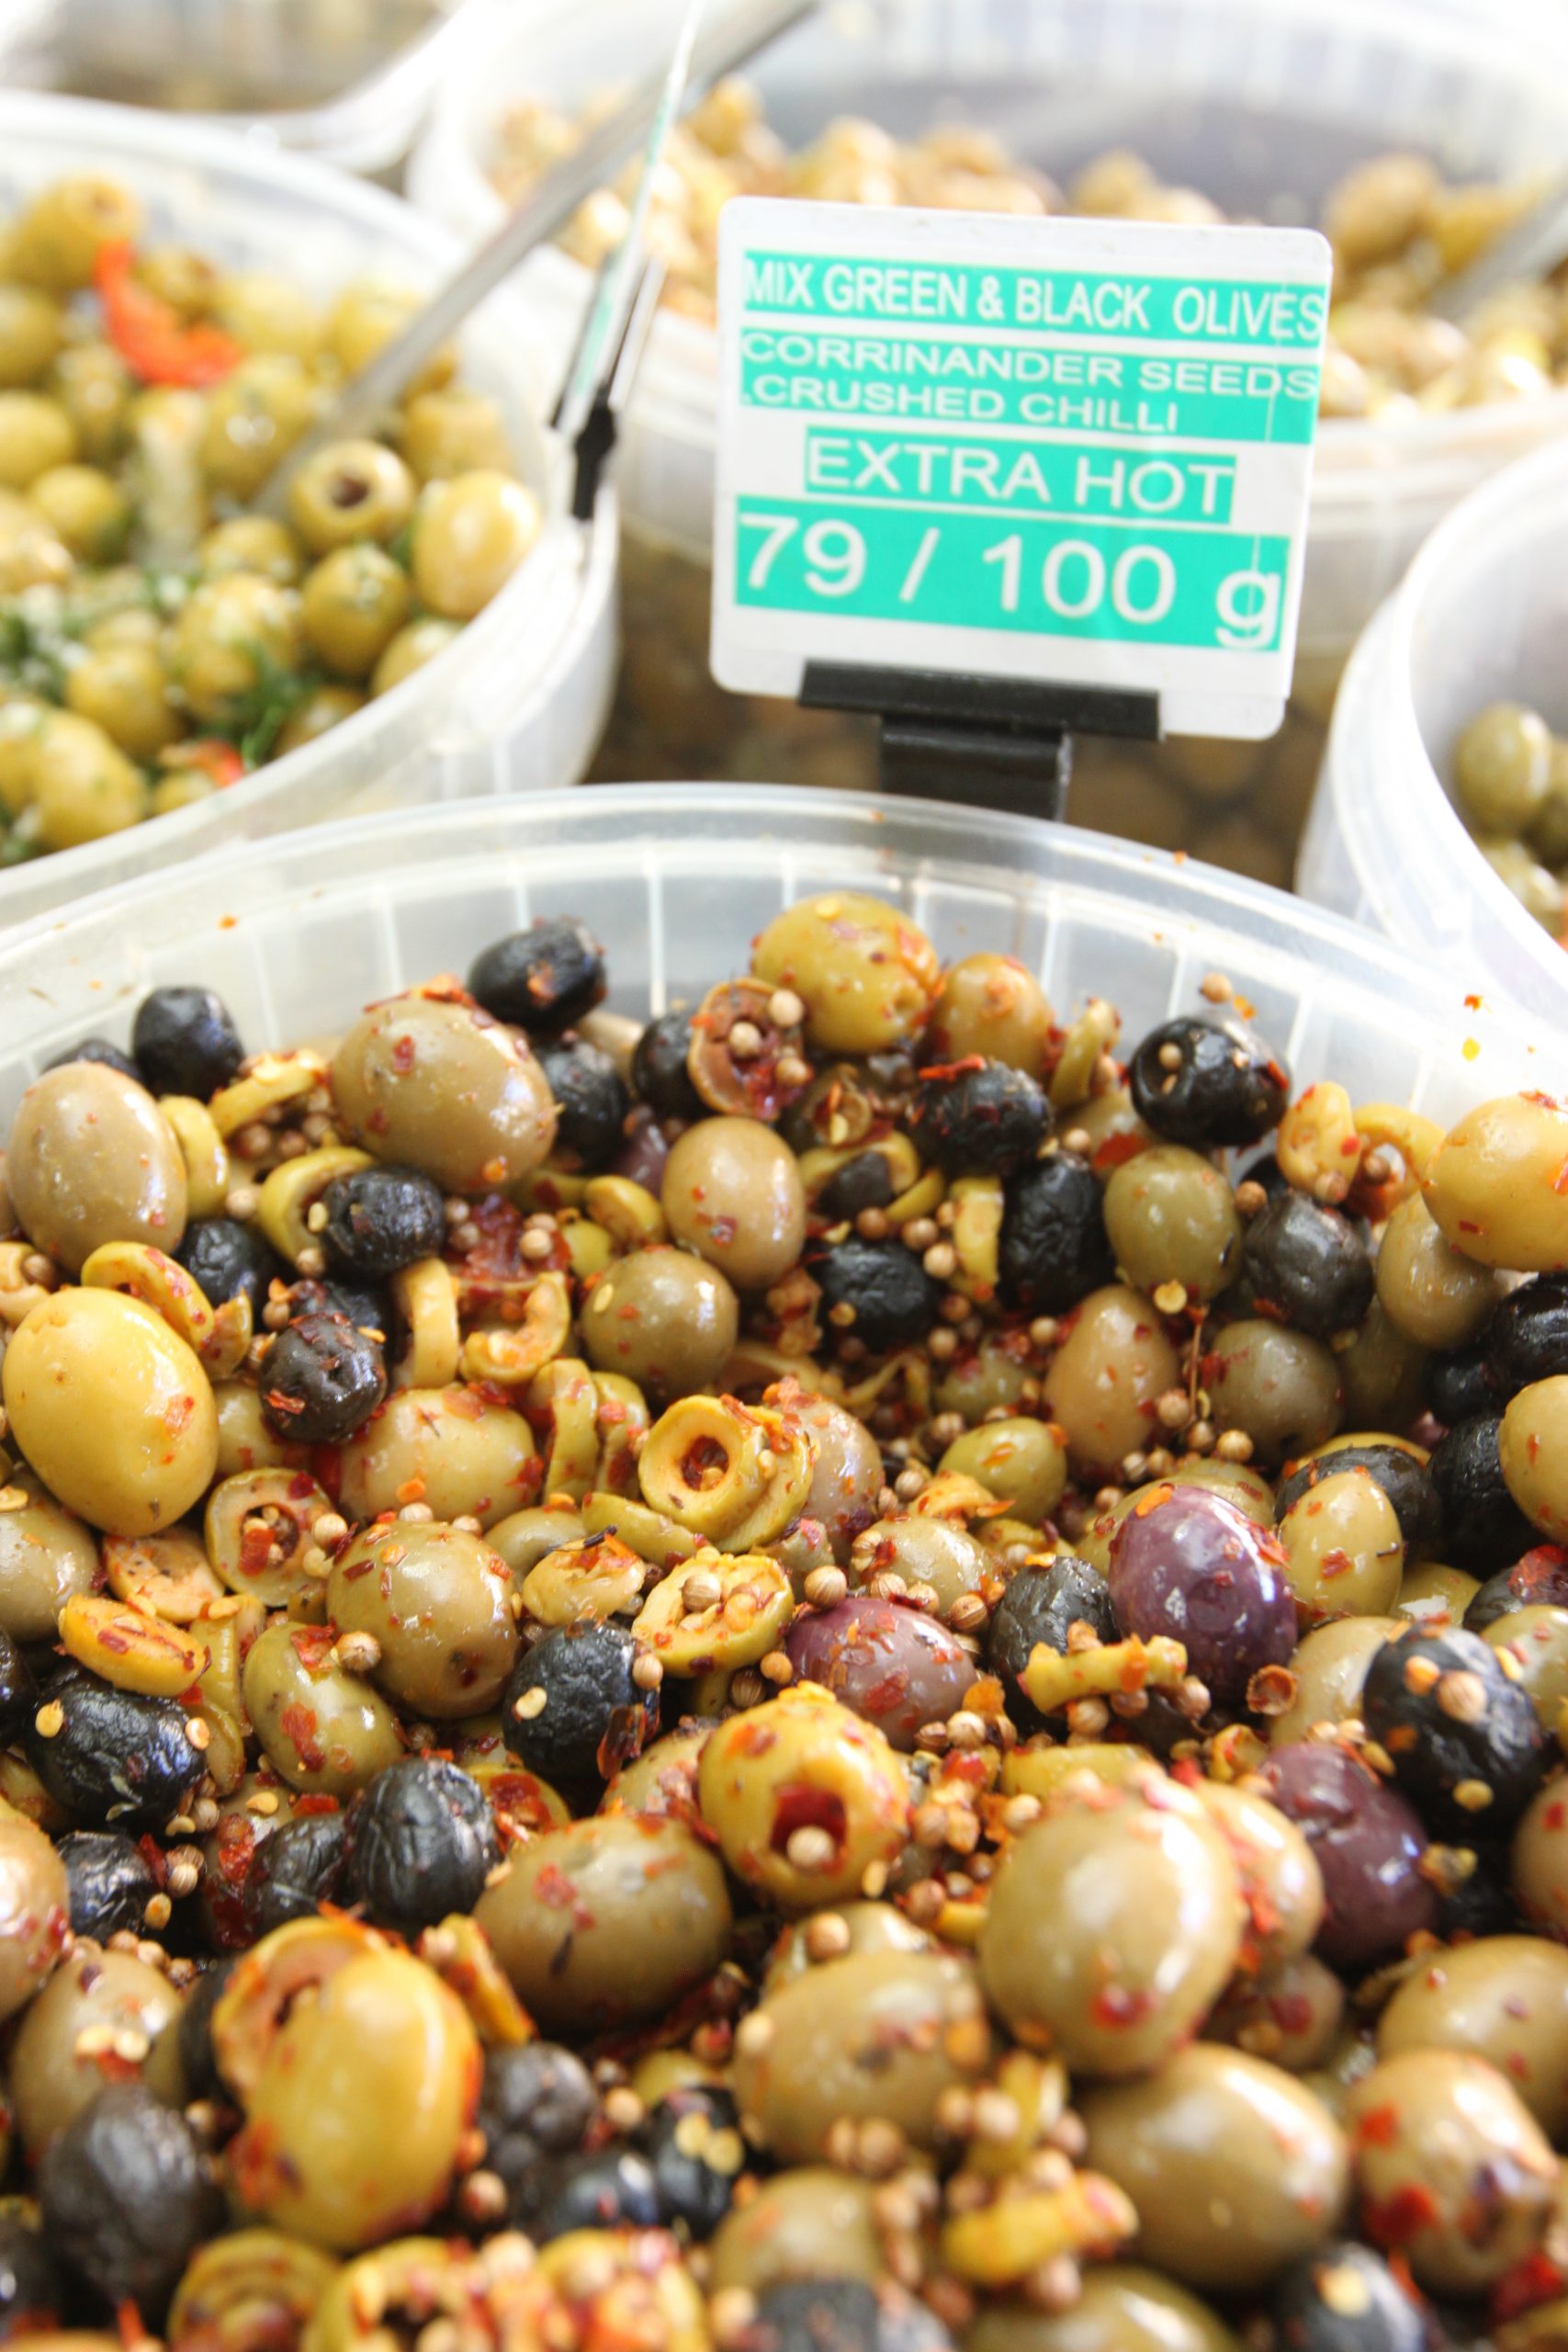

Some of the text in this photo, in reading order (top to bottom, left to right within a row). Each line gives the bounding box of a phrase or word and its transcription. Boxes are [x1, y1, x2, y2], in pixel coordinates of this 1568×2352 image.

[743, 258, 1324, 340] MIX GREEN & BLACK OLIVES
[742, 333, 1317, 398] CORRINANDER SEEDS
[1019, 393, 1178, 433] CHILLI
[808, 437, 1234, 514] EXTRA HOT
[739, 514, 1281, 649] 79 / 100 g
